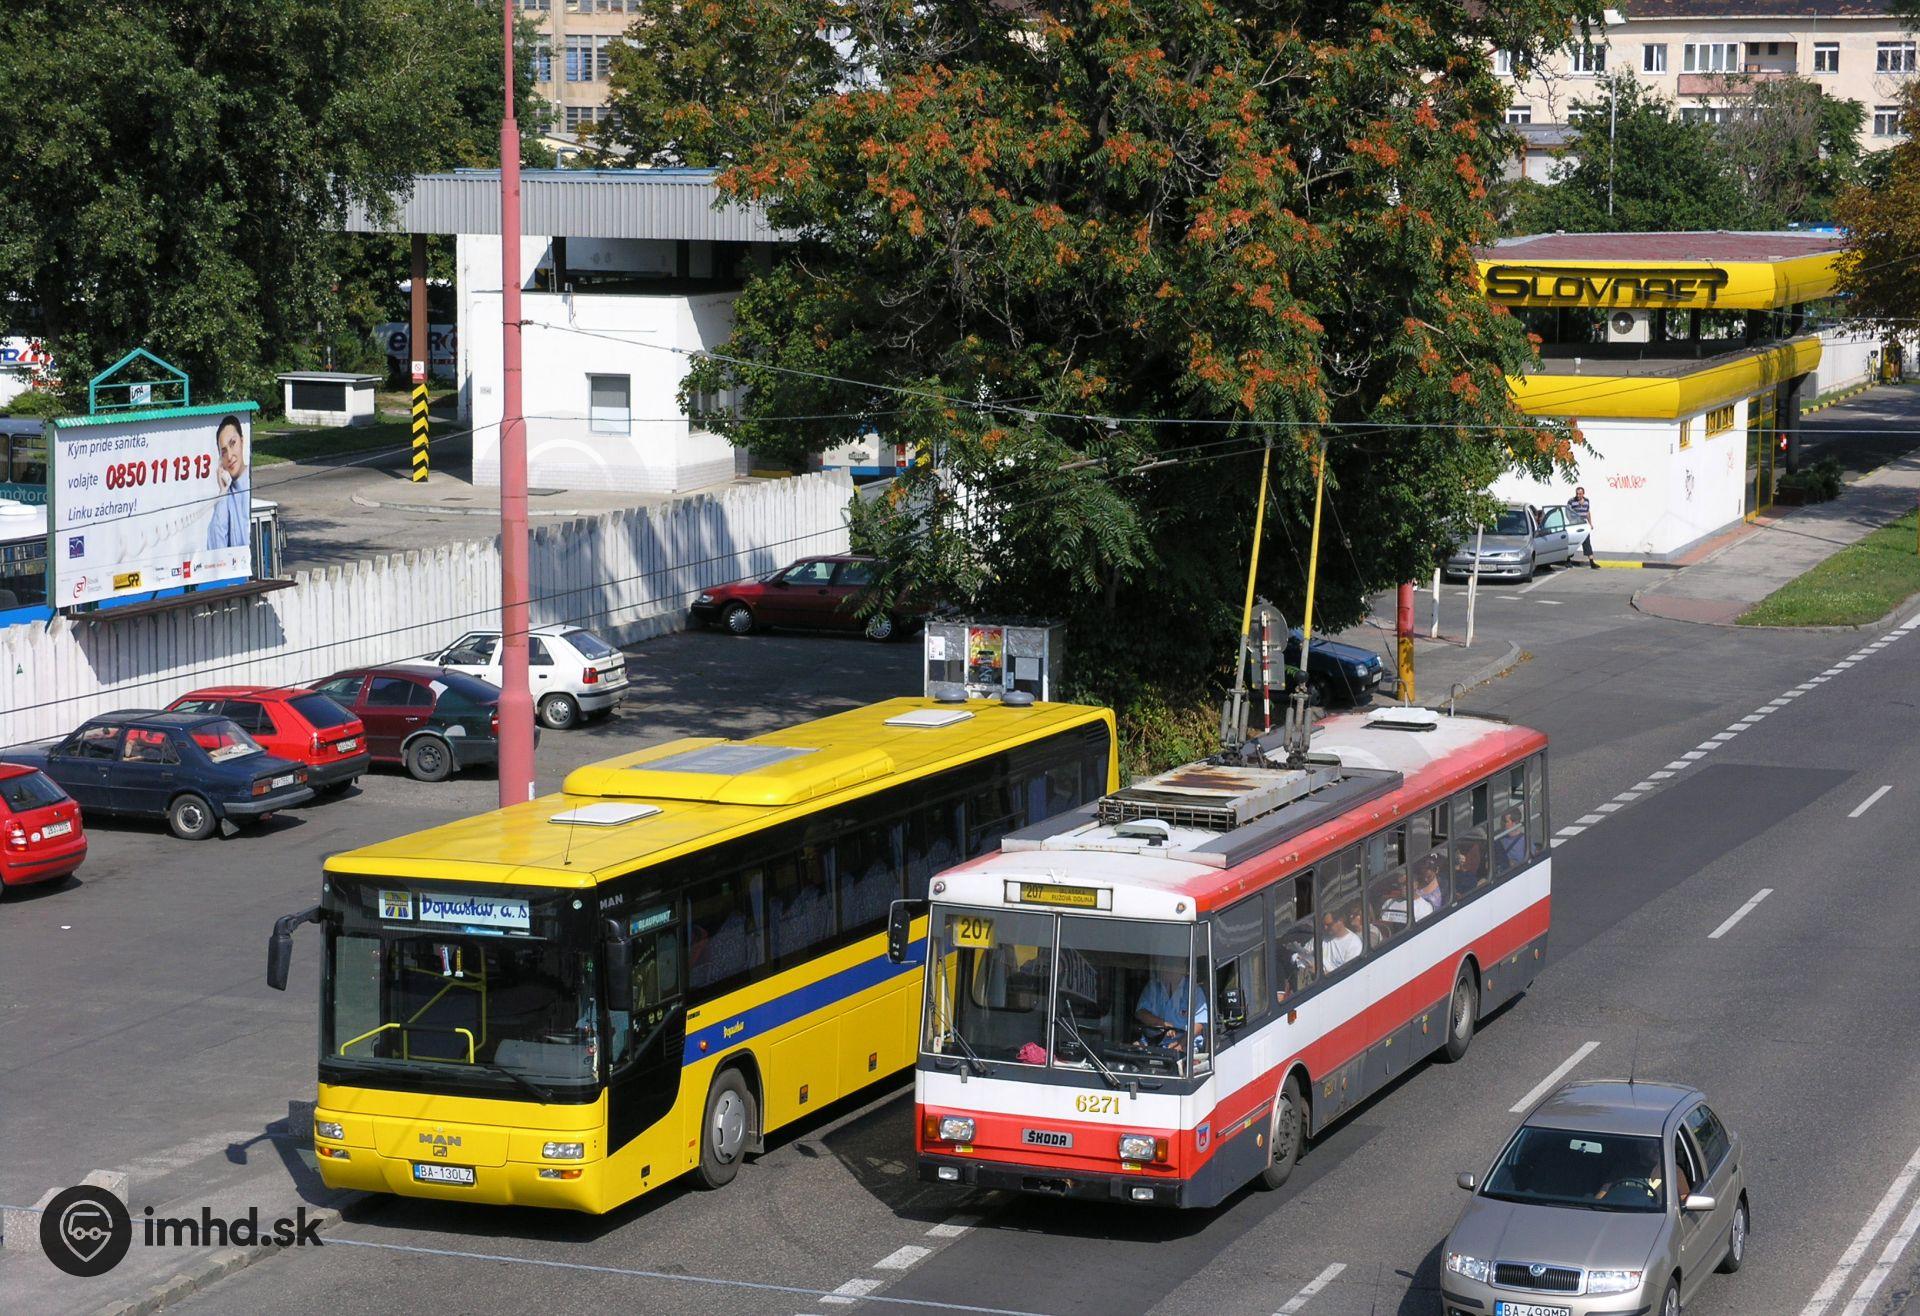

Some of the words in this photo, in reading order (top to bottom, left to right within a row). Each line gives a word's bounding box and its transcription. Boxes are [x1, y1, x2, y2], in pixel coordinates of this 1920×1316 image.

[1486, 265, 1728, 304] SLOVNAFT
[68, 442, 88, 460] Kým
[68, 473, 98, 490] volajte
[106, 460, 147, 491] 0850
[151, 458, 168, 484] 11
[173, 455, 191, 481] 13
[194, 453, 211, 479] 13
[68, 504, 93, 521] Linku
[94, 498, 137, 518] záchrany!
[1026, 884, 1043, 899] 207
[600, 894, 623, 910] MAN
[961, 918, 994, 940] 207
[1076, 1094, 1120, 1115] 6271
[419, 1133, 462, 1147] MAN
[1028, 1130, 1067, 1146] ŠKODA
[420, 1165, 473, 1181] BA-130LZ
